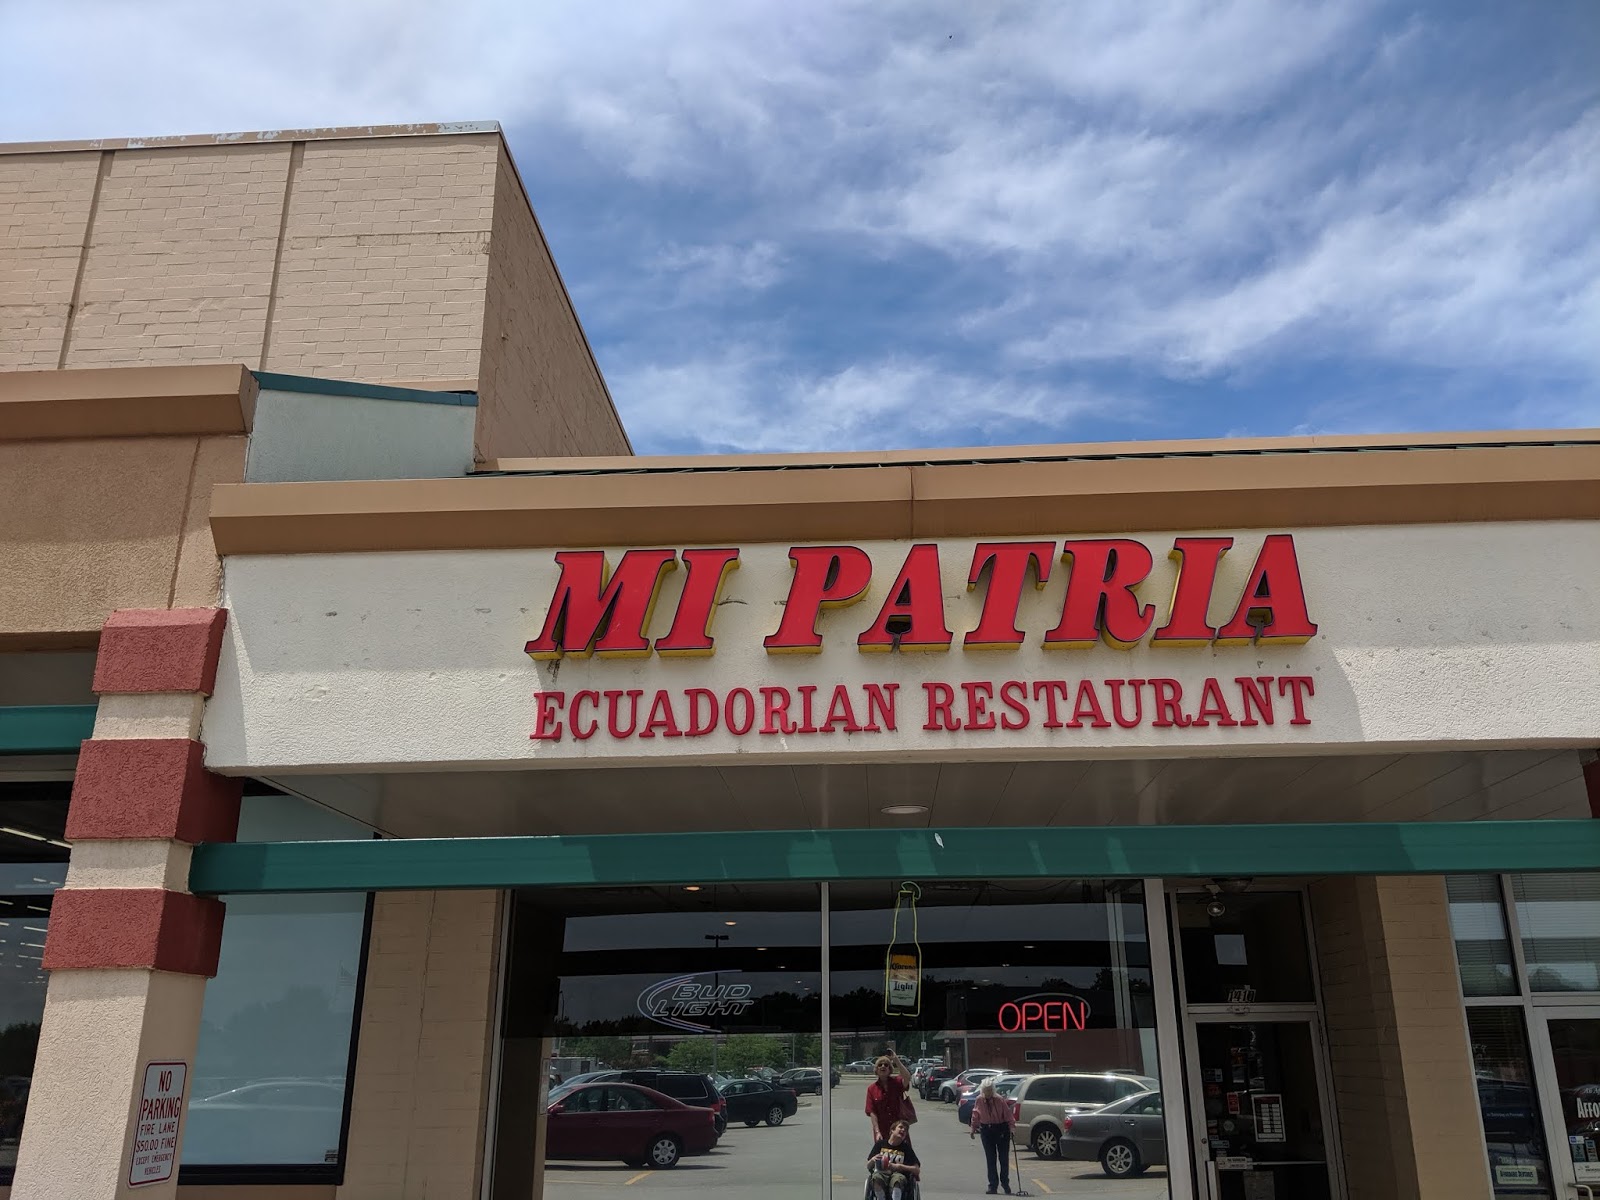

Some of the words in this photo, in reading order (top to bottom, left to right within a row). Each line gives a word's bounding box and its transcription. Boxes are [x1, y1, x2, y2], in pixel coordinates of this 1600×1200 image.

[524, 547, 741, 658] MI
[763, 534, 1318, 652] PATRIA
[530, 683, 900, 740] ECUADORIAN
[922, 676, 1315, 731] RESTAURANT
[672, 983, 751, 1000] BUD
[893, 980, 913, 991] Light
[651, 1000, 754, 1016] LIGHT
[998, 1001, 1085, 1032] OPEN
[158, 1070, 173, 1092] NO
[141, 1097, 180, 1121] PARKING
[1576, 1097, 1600, 1118] AFFO
[140, 1123, 155, 1136] FIRE
[159, 1121, 176, 1134] LANE
[136, 1139, 158, 1153] $50.00
[161, 1137, 175, 1149] FINE
[152, 1153, 172, 1163] EMERGENCY
